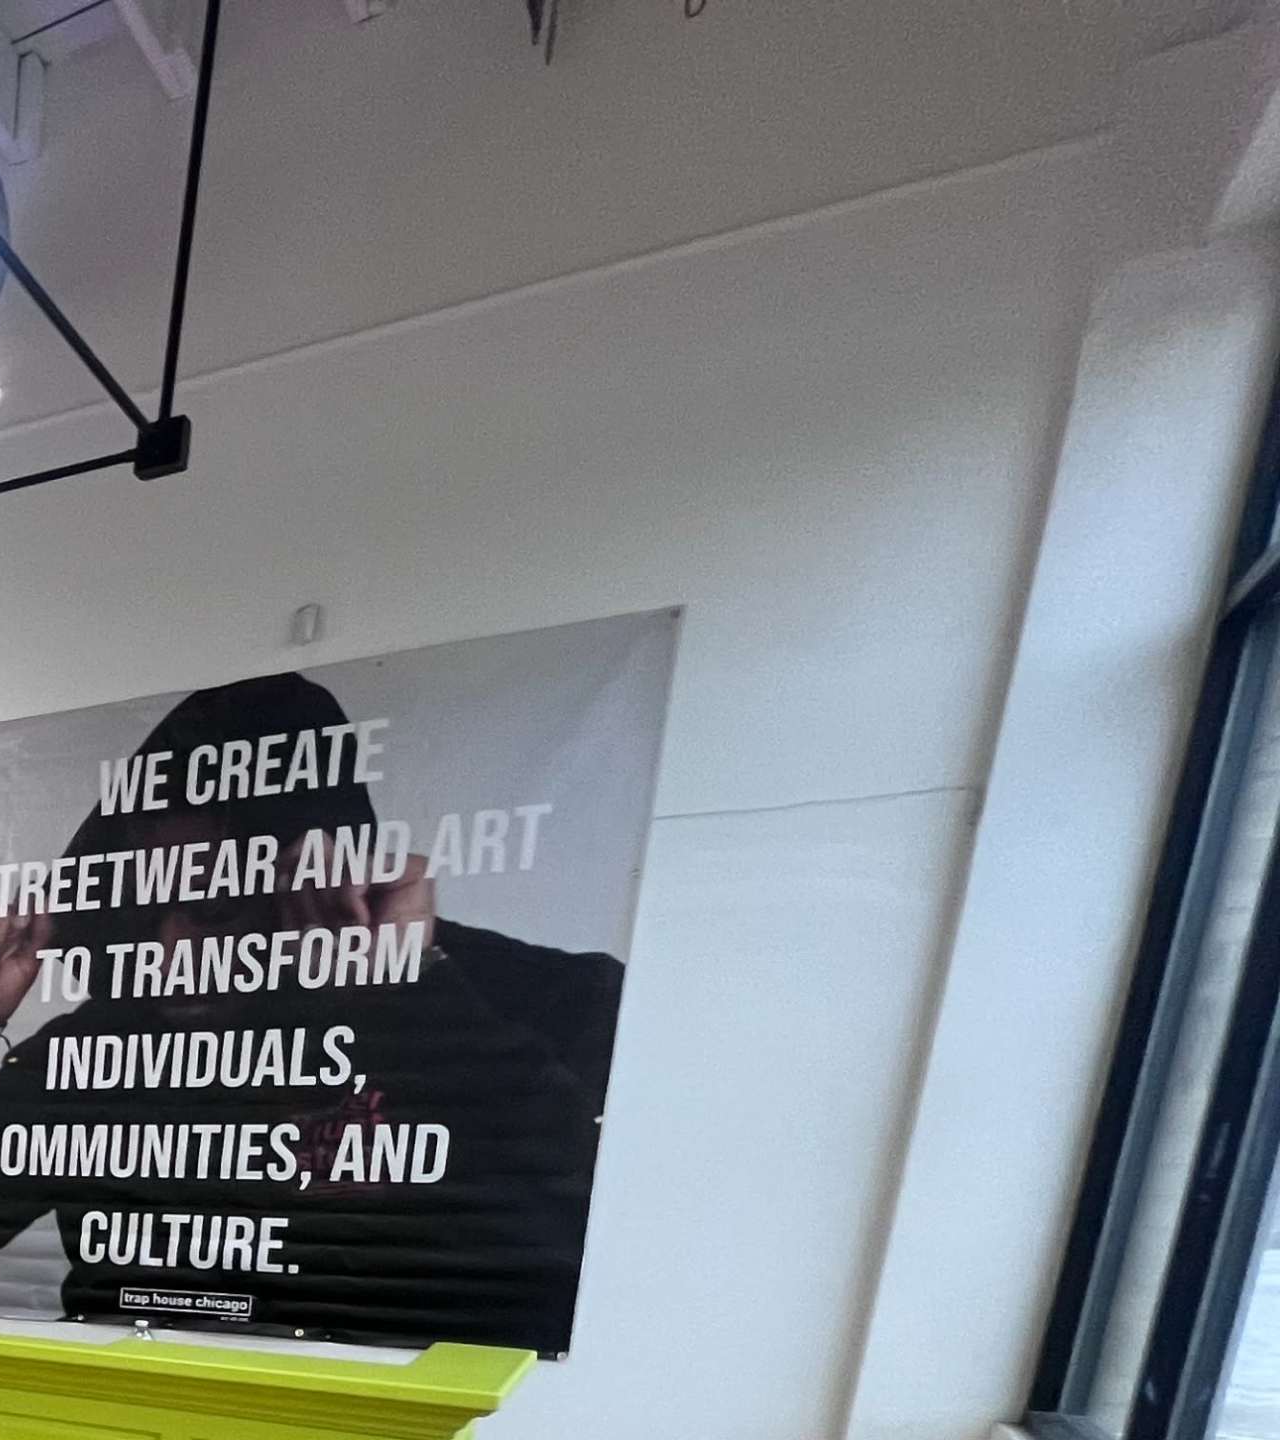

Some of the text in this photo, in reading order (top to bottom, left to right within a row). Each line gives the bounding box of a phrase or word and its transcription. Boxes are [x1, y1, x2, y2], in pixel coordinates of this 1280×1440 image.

[99, 718, 389, 816] WE CREATE
[290, 820, 411, 892] AND
[424, 803, 552, 880] ART
[37, 921, 425, 1003] TO TRANSFORM
[45, 1025, 367, 1095] INDIVIDUALS,
[330, 1124, 450, 1184] AND
[79, 1210, 300, 1275] CULTURE.
[124, 1292, 248, 1313] trap house chicago
